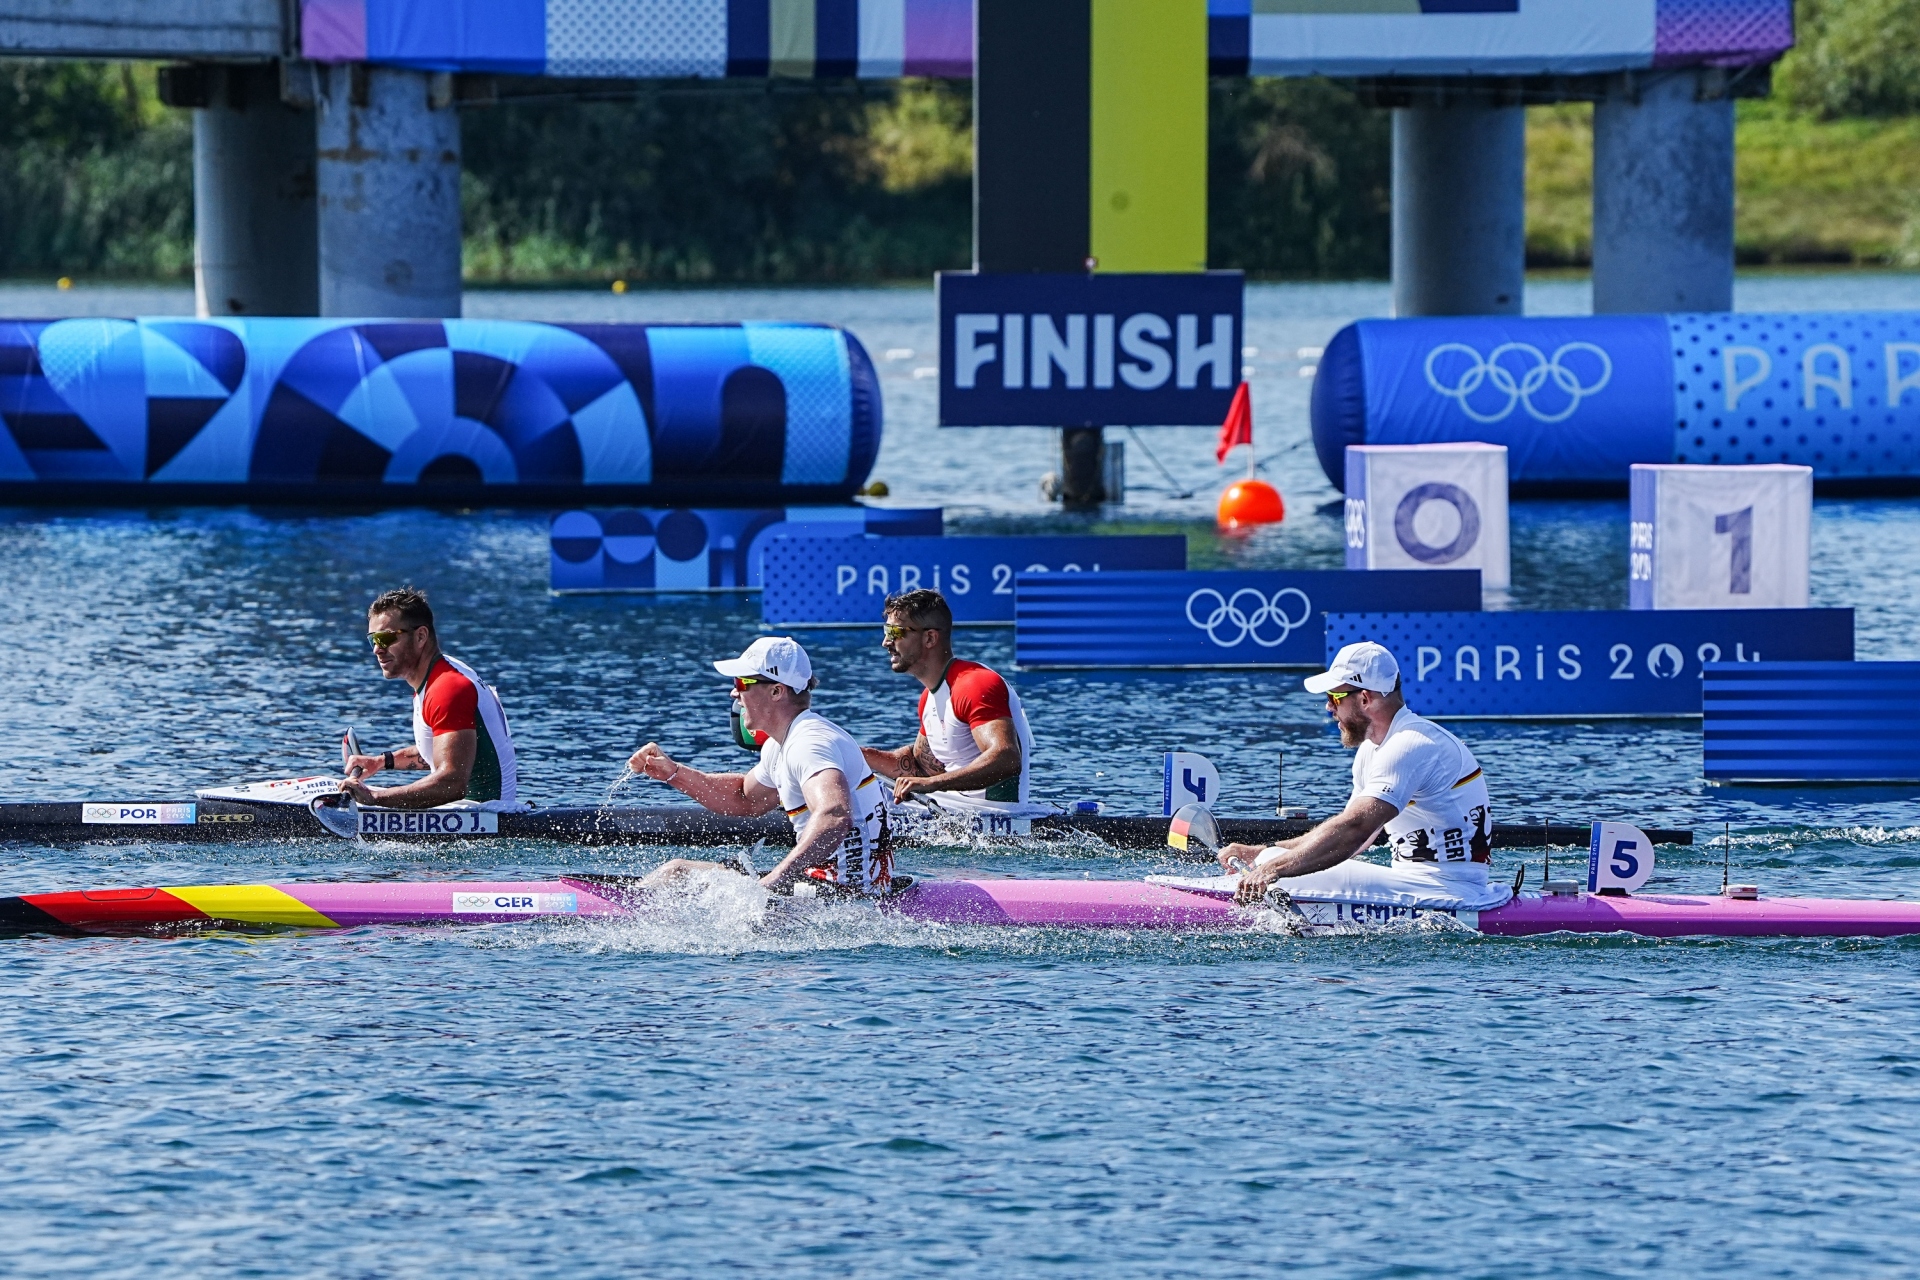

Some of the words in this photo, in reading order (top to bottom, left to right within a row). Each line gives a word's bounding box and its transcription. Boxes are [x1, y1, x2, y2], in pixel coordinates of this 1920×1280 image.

[955, 313, 1233, 389] FINISH
[1715, 505, 1754, 595] 1
[1183, 768, 1207, 802] 4
[120, 808, 157, 819] POR
[362, 812, 463, 833] RIBEIRO
[470, 812, 486, 833] J.
[1610, 840, 1639, 879] 5
[494, 897, 534, 908] GER
